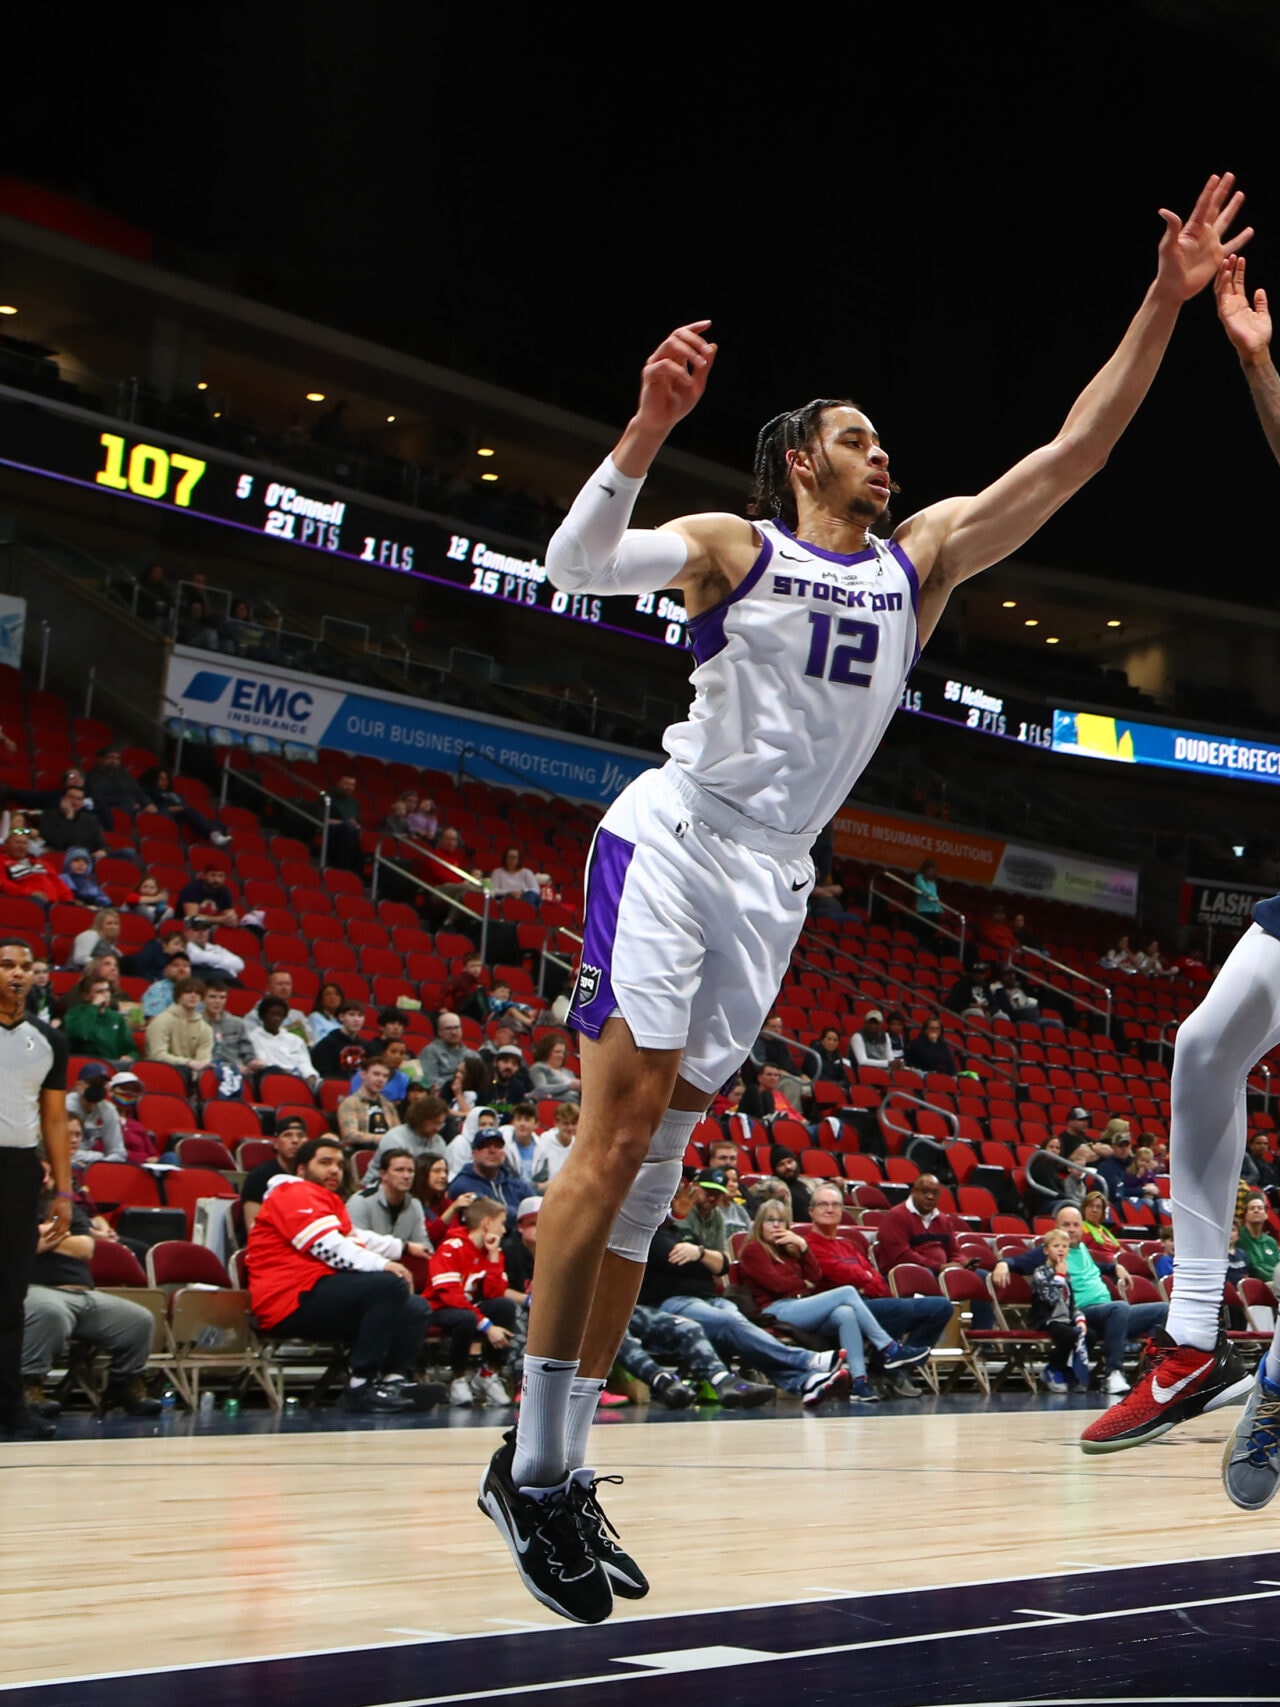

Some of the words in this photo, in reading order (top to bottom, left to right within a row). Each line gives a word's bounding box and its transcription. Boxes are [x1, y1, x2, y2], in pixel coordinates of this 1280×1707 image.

[97, 432, 207, 507] 107
[237, 474, 253, 499] 5
[264, 482, 346, 525] O'Connell
[264, 511, 296, 539] 21
[301, 518, 341, 552] PTS
[360, 536, 375, 562] 1
[380, 540, 414, 572] FLS
[446, 535, 469, 561] 12
[471, 542, 548, 584] Comanche
[469, 567, 500, 596] 15
[503, 574, 538, 606] PTS
[551, 590, 569, 614] 0
[571, 593, 602, 623] FLS
[773, 575, 903, 612] STOCKON
[664, 622, 682, 646] 0
[804, 610, 880, 688] 12
[227, 711, 308, 735] INSURANCE
[231, 678, 314, 723] EMC
[346, 715, 385, 740] OUR
[390, 721, 474, 759] BUSINESS
[501, 748, 597, 785] PROTECTING
[981, 711, 1006, 736] PTS
[1017, 722, 1028, 741] 1
[1029, 723, 1052, 748] FLS
[871, 825, 933, 853] INSURANCE
[935, 839, 994, 865] SOLUTIONS
